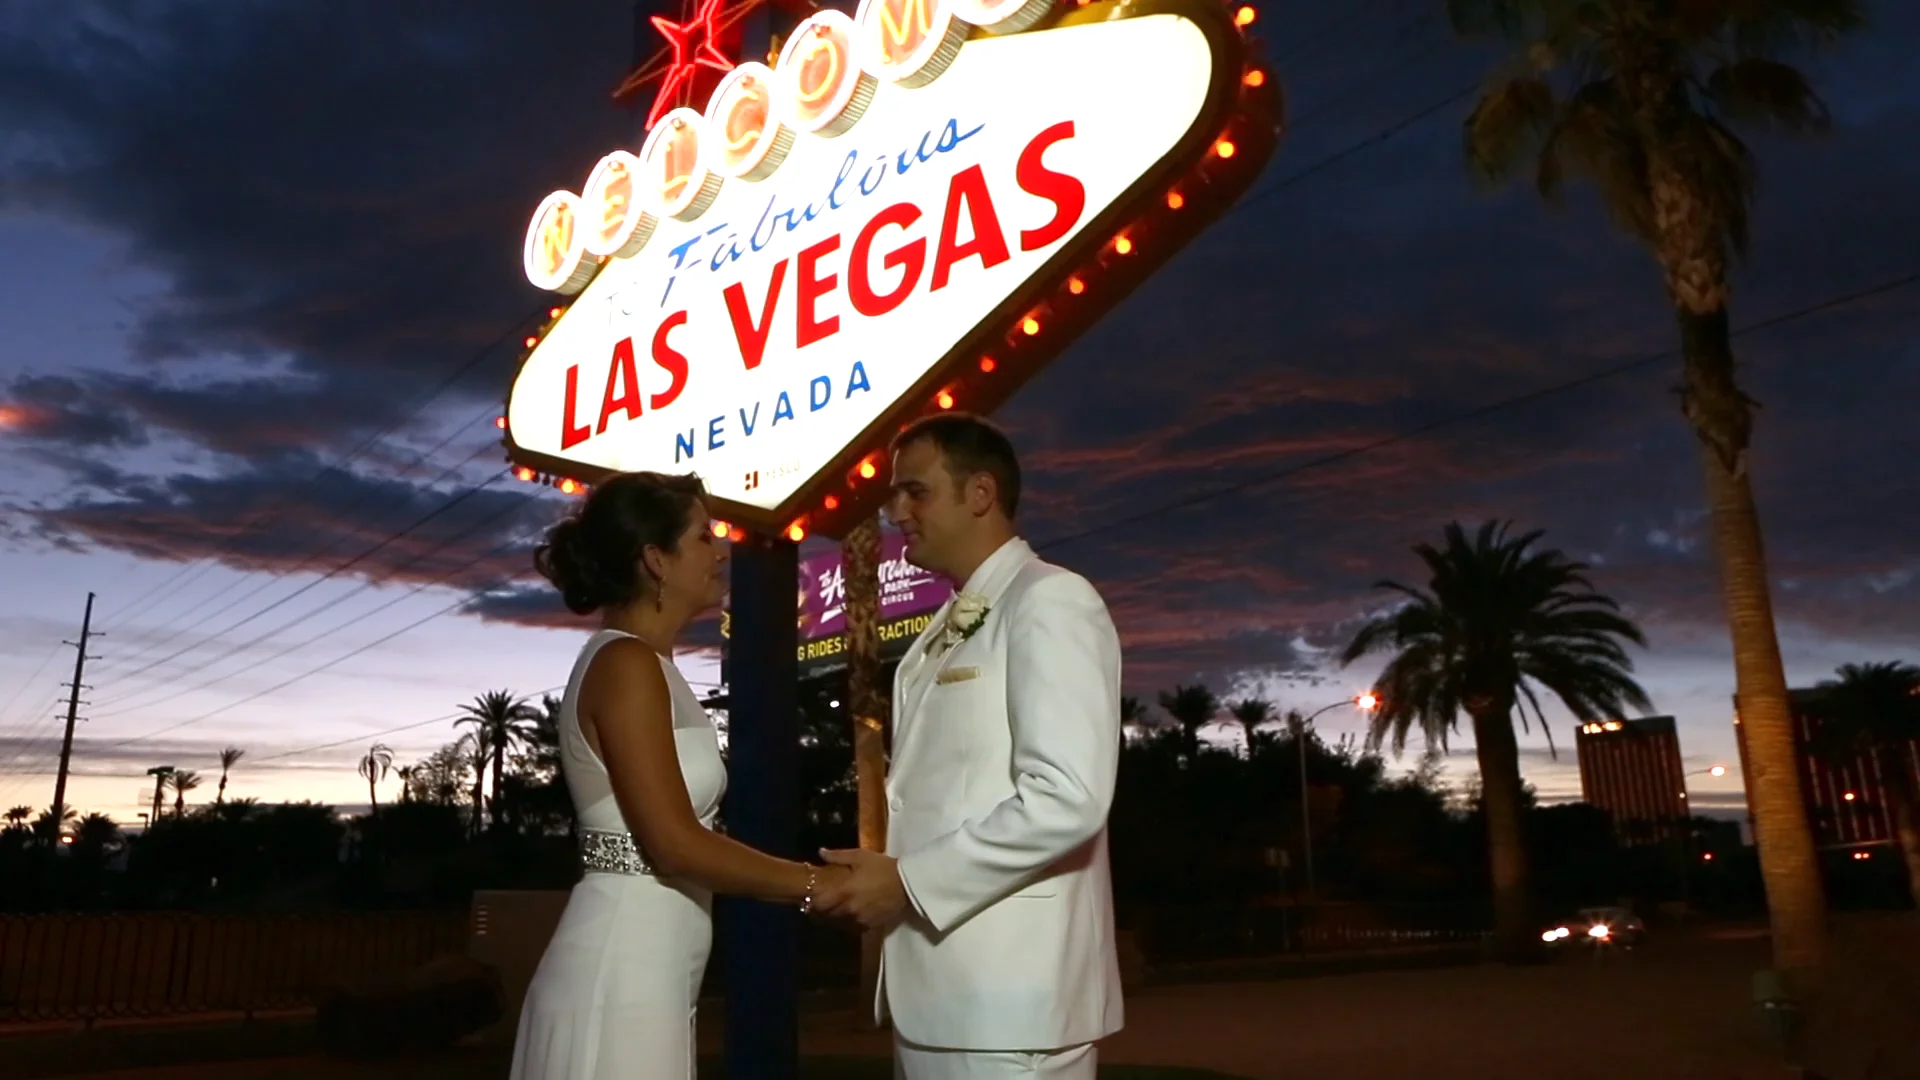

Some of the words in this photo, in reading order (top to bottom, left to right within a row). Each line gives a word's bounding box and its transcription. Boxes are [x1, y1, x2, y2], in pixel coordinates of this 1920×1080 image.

[530, 0, 1020, 280] WELCOM
[660, 117, 986, 309] Fabulous
[560, 310, 690, 452] LAS
[722, 119, 1088, 372] VEGAS
[674, 359, 873, 464] NEVADA
[807, 636, 842, 659] RIDES
[878, 613, 935, 641] RACTION
